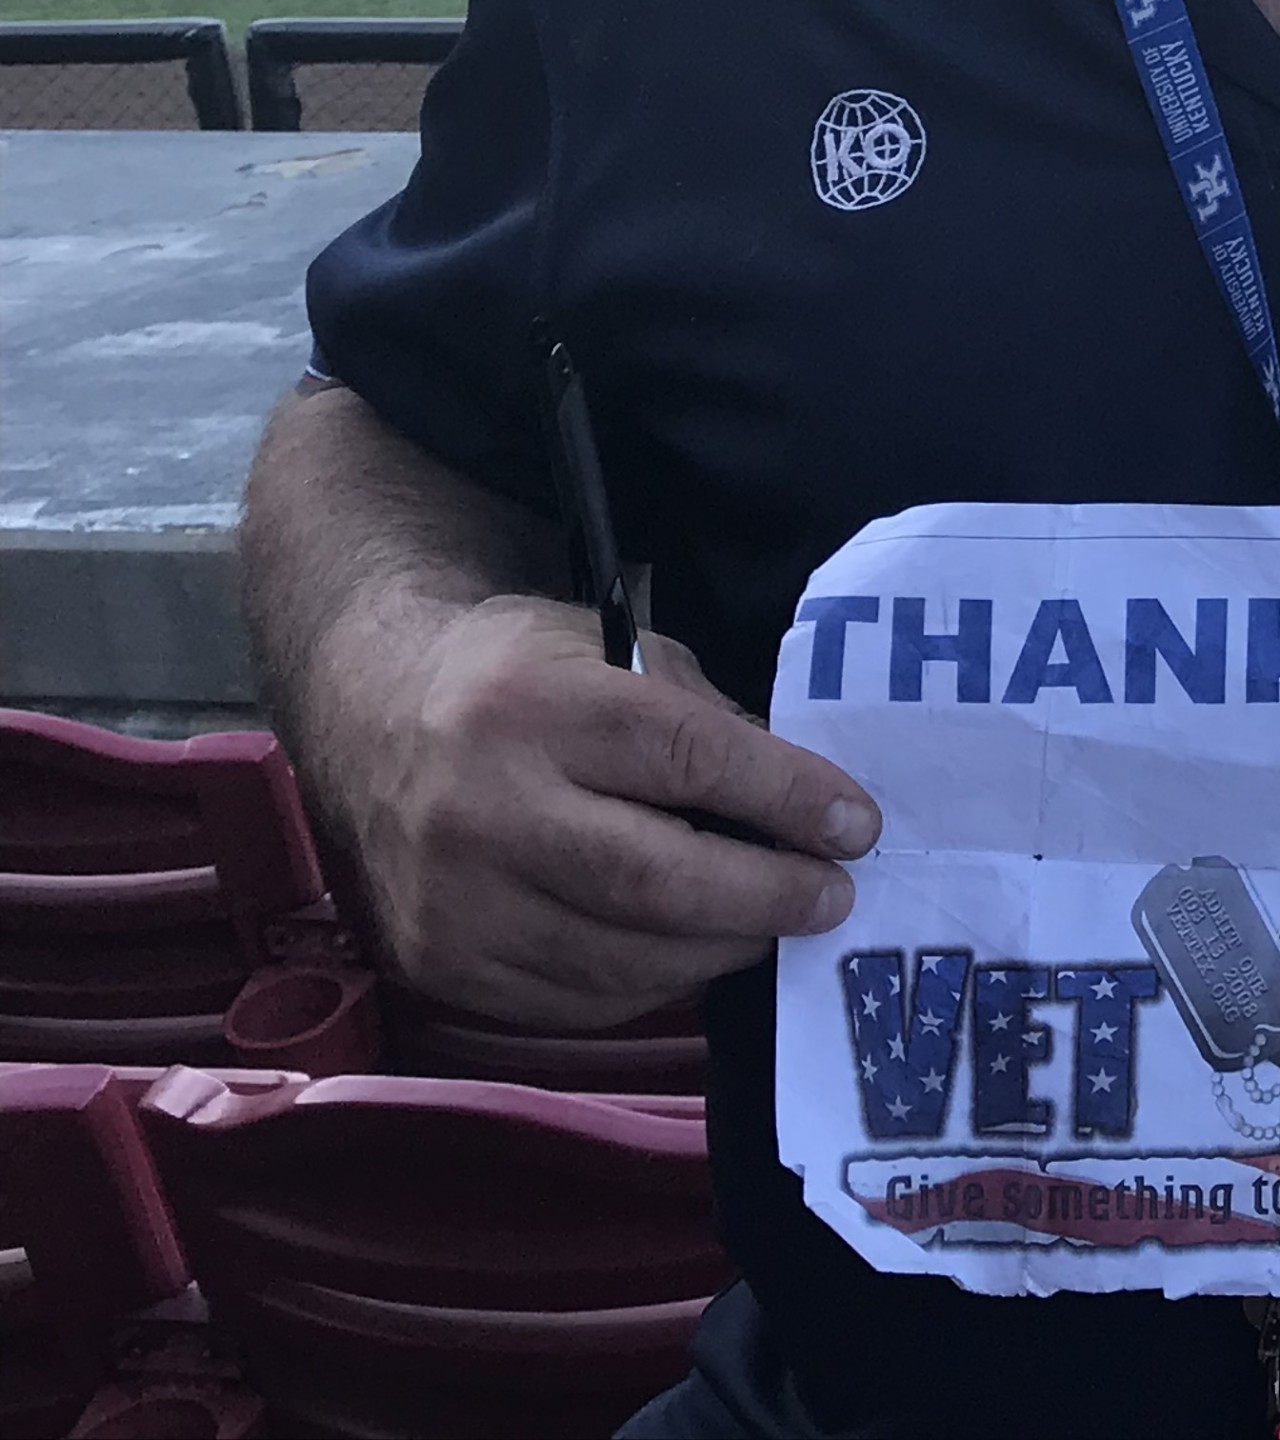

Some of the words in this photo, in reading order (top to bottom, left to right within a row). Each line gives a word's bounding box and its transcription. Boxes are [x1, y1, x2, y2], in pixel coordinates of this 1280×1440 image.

[1141, 47, 1162, 65] OF
[1160, 40, 1210, 134] KENTUCKY
[1150, 65, 1194, 144] UNIVERSITY
[1220, 263, 1257, 341] UNIVERSITY
[1225, 236, 1265, 333] KENTUCKY
[1166, 902, 1241, 1023] VETTIX.ORG
[1199, 887, 1241, 951] ADMIT
[1239, 955, 1268, 998] ONE
[1223, 967, 1258, 1018] 2008
[840, 948, 1161, 1140] VET
[886, 1174, 985, 1220] Give
[1003, 1175, 1234, 1224] something
